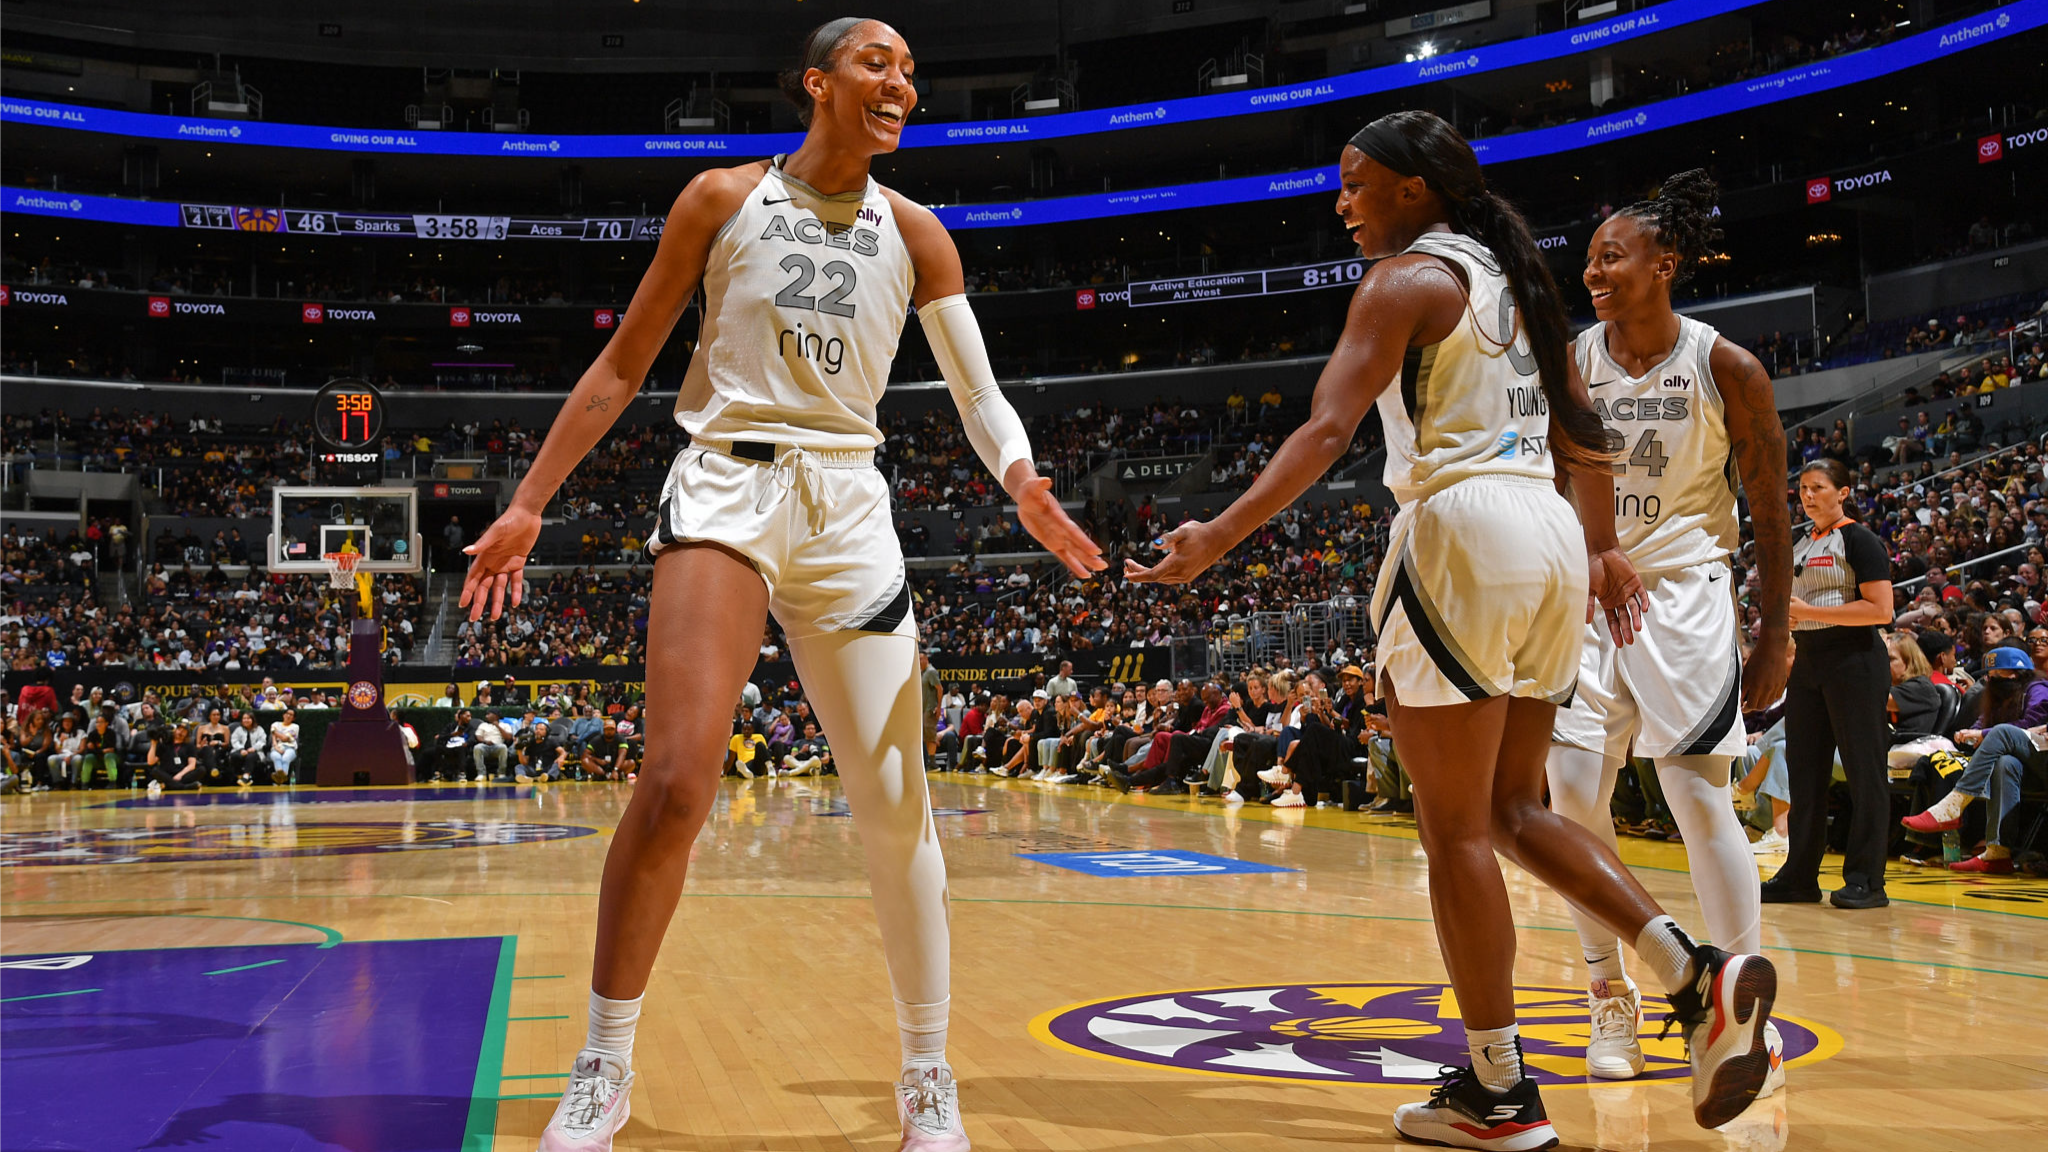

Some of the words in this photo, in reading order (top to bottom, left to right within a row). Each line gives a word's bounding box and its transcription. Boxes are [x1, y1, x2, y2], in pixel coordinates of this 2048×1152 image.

[1570, 27, 1610, 45] GIVING
[1611, 20, 1638, 36] OUR
[1638, 13, 1660, 29] ALL
[1938, 20, 1994, 48] Anthem
[1418, 59, 1466, 78] Anthem
[1250, 92, 1288, 106] GIVING
[1289, 89, 1313, 101] OUR
[1314, 84, 1334, 97] ALL
[34, 107, 60, 120] OUR
[62, 109, 86, 122] ALL
[1109, 110, 1154, 125] Anthem
[178, 123, 228, 138] Anthem
[947, 126, 984, 138] GIVING
[985, 125, 1008, 136] OUR
[1009, 124, 1030, 135] ALL
[1586, 117, 1634, 138] Anthem
[330, 133, 369, 146] GIVING
[370, 134, 395, 146] OUR
[396, 135, 417, 146] ALL
[502, 140, 547, 152] Anthem
[644, 140, 681, 150] GIVING
[683, 140, 706, 150] OUR
[707, 140, 727, 150] ALL
[1268, 178, 1314, 193] Anthem
[1834, 170, 1893, 193] TOYOTA
[16, 195, 68, 211] Anthem
[192, 214, 202, 226] 4
[215, 215, 224, 227] 1
[297, 213, 325, 232] 46
[856, 208, 883, 227] ally
[965, 209, 1010, 223] Anthem
[354, 219, 401, 234] Sparks
[425, 217, 479, 238] 3:58
[494, 223, 505, 239] 3
[530, 224, 563, 236] Aces
[597, 222, 622, 239] 70
[640, 225, 665, 236] ACE
[760, 214, 880, 257] ACES
[1302, 262, 1364, 287] 8:10
[774, 253, 857, 319] 22
[1150, 280, 1184, 293] Active
[1187, 274, 1245, 290] Education
[14, 290, 68, 306] TOYOTA
[1173, 288, 1195, 300] Air
[1198, 287, 1221, 298] West
[174, 302, 226, 316] TOYOTA
[326, 308, 376, 322] TOYOTA
[474, 311, 521, 324] TOYOTA
[779, 322, 845, 375] ring
[1663, 375, 1691, 391] ally
[336, 394, 373, 411] 3:58
[1506, 385, 1547, 419] YOUNG
[1979, 394, 1991, 407] 109
[1591, 397, 1689, 421] ACES
[341, 411, 370, 441] 17
[1521, 435, 1546, 456] AT
[335, 454, 379, 463] TISSOT
[450, 487, 481, 495] TOYOTA
[1615, 486, 1661, 525] ing
[938, 668, 988, 681] RTSIDE
